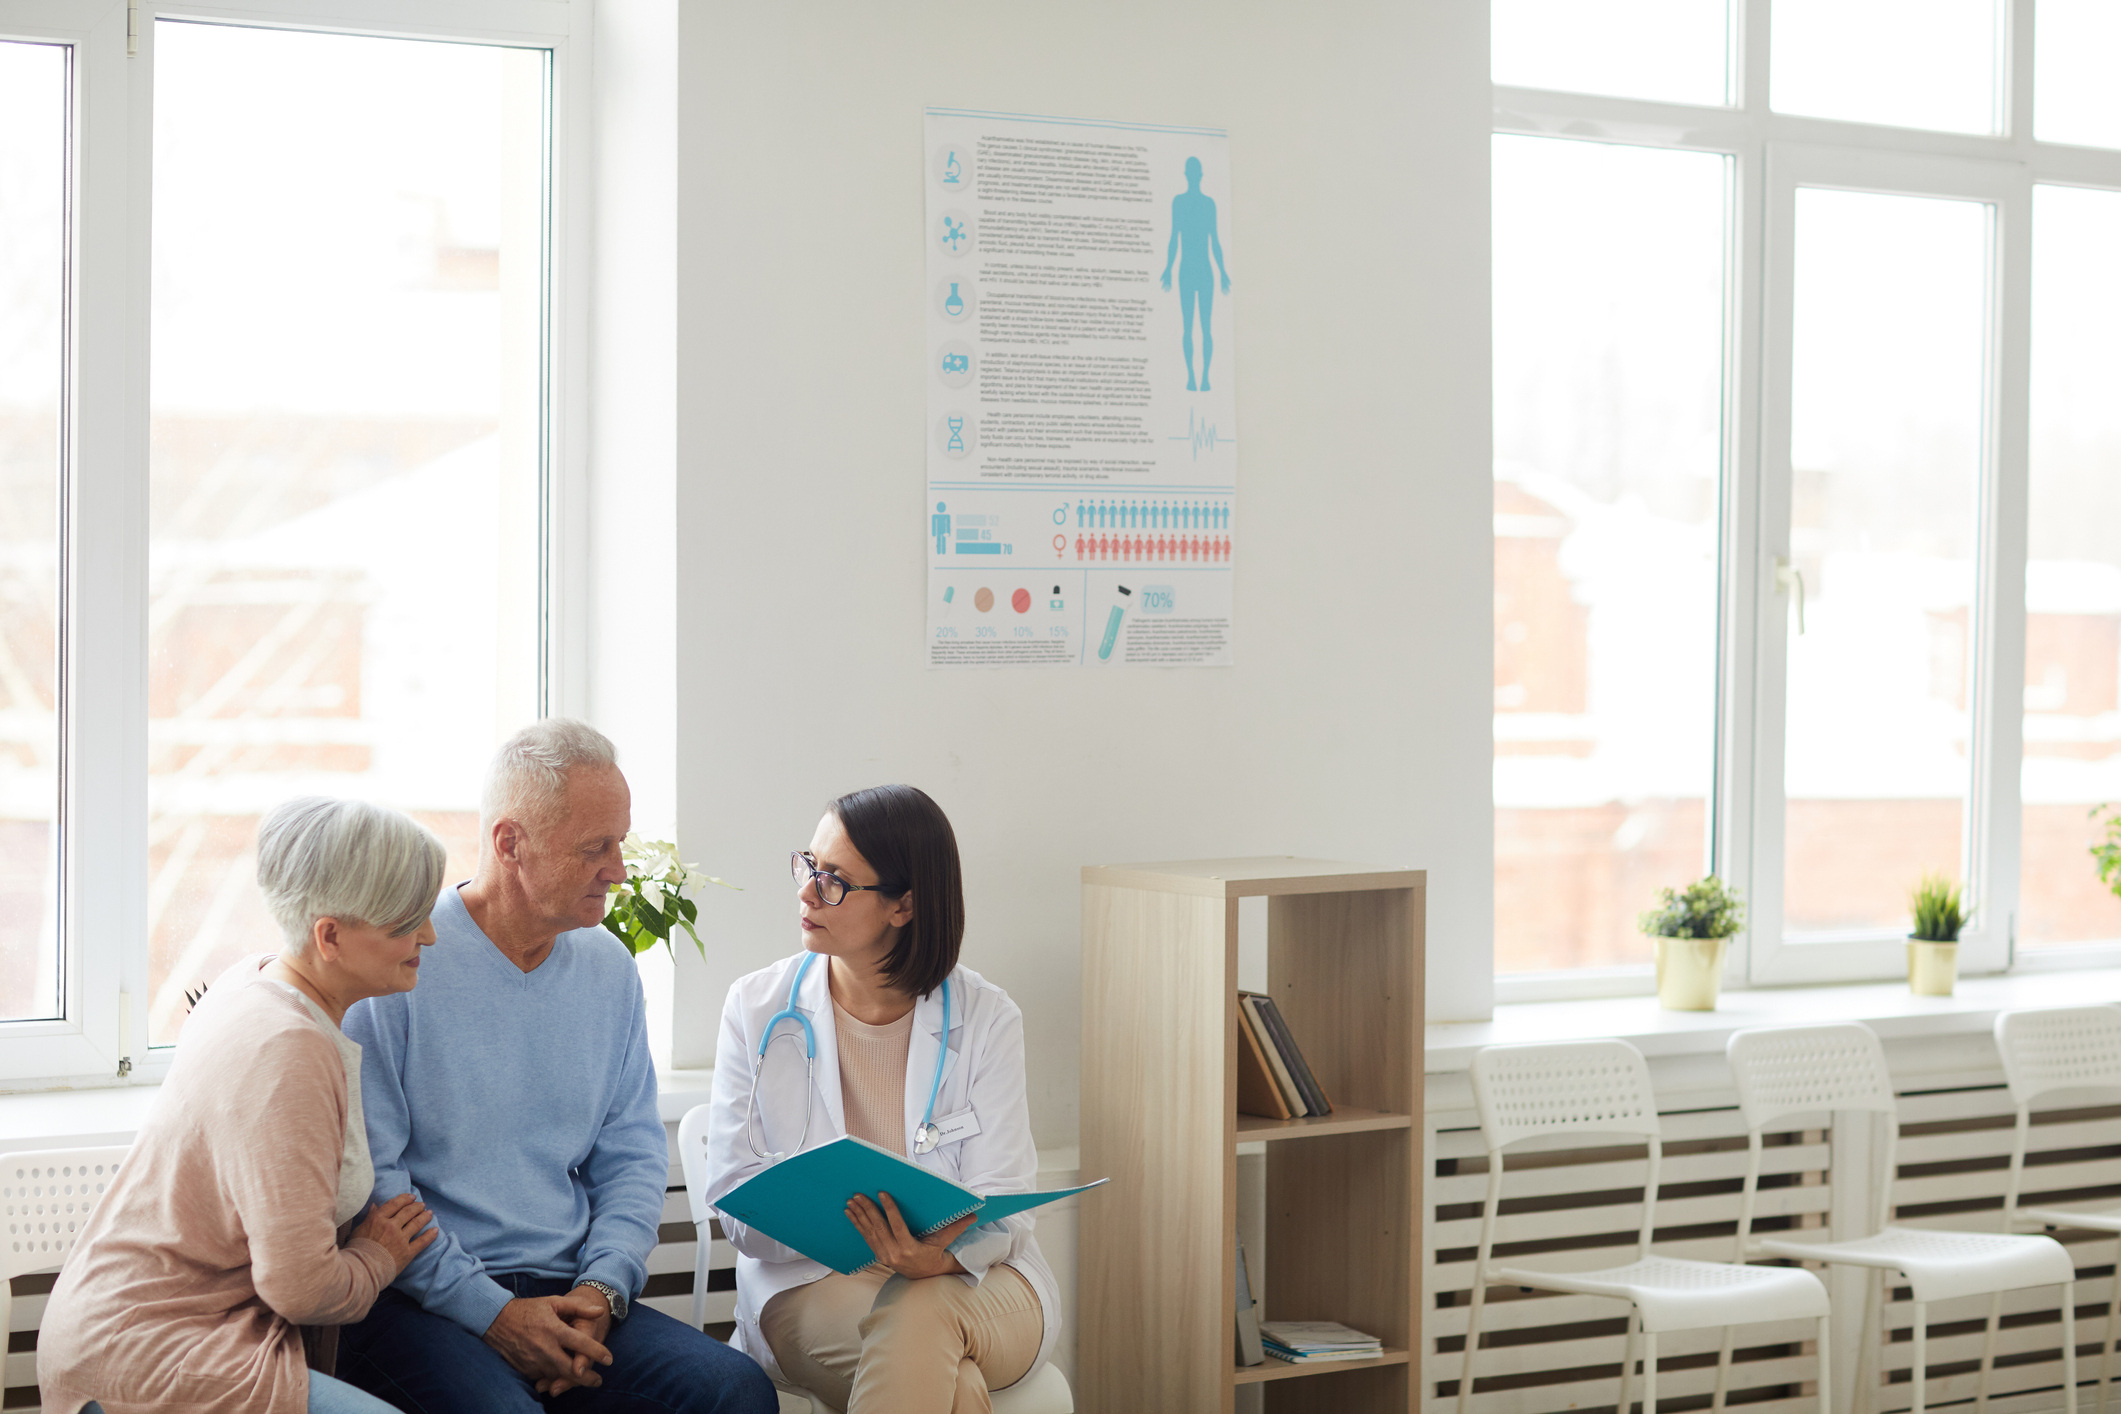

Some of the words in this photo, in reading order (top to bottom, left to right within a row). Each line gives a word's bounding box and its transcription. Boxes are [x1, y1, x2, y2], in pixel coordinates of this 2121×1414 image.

[981, 529, 992, 540] 45
[1002, 544, 1012, 554] 70
[1144, 592, 1173, 608] 70%
[936, 626, 958, 638] 20%
[976, 626, 998, 638] 30%
[1014, 626, 1034, 638] 10%
[1050, 626, 1070, 638] 15%
